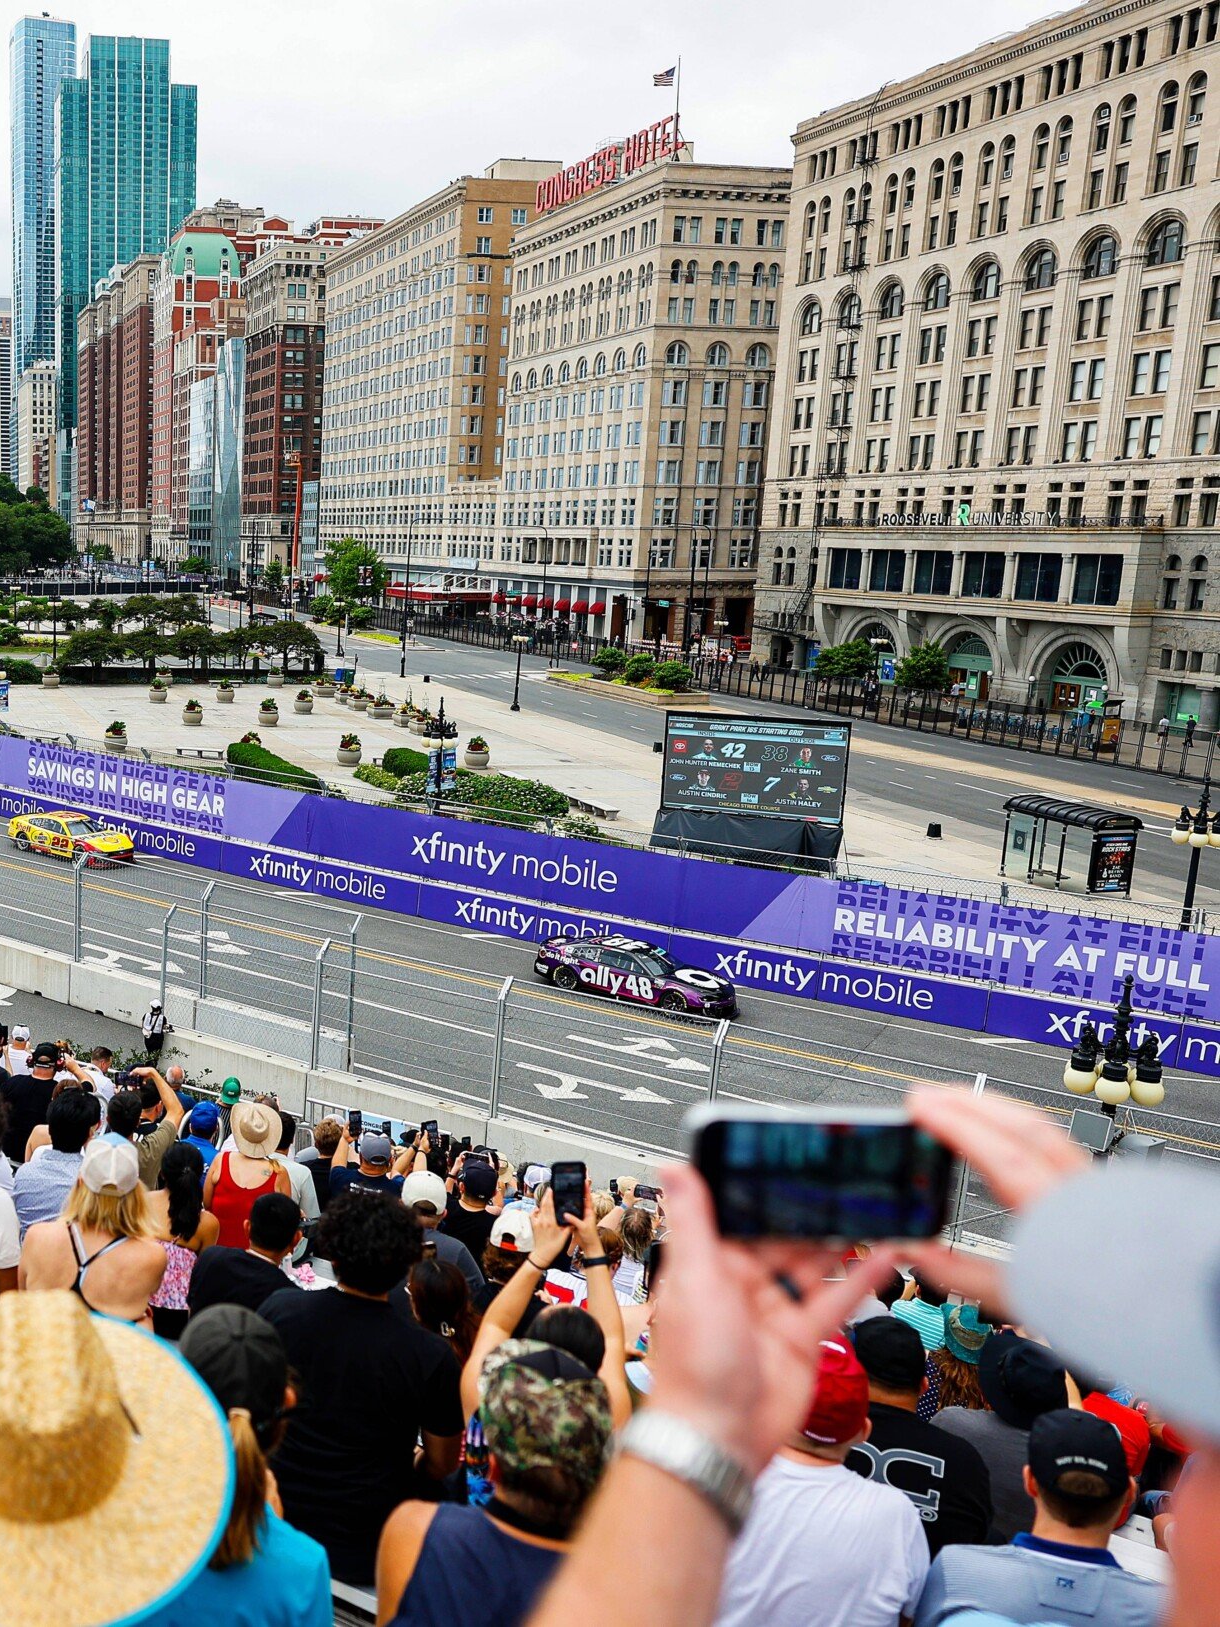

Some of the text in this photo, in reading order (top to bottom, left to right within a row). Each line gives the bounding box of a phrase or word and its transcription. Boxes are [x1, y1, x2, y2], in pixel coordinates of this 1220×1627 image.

[536, 112, 685, 213] CONGRESS HOTEL
[881, 512, 952, 526] ROOSEVELT
[972, 511, 1058, 526] UNIVERSITY
[709, 724, 730, 732] GRANT
[730, 725, 747, 733] PARK
[758, 727, 788, 736] STARTING
[788, 729, 804, 737] GRID
[720, 742, 747, 759] 42
[760, 744, 789, 762] 38
[684, 759, 708, 767] HUNTER
[708, 761, 741, 769] NEMECHEK
[798, 768, 822, 776] SMITH
[27, 757, 226, 816] SAVINGS IN HIGH GEAR
[763, 776, 781, 792] 7
[677, 789, 727, 799] AUSTIN CINDRIC
[718, 801, 740, 809] CHICAGO
[774, 798, 822, 808] JUSTIN HALEY
[15, 822, 32, 833] Shell
[51, 836, 70, 848] 22
[96, 816, 138, 841] finity
[140, 830, 195, 857] mobile
[411, 831, 618, 893] xfinity mobile
[250, 853, 386, 900] xfinity mobile
[454, 898, 536, 935] xfinity
[833, 908, 1211, 992] RELIABILITY AT FULL
[560, 955, 580, 966] right.
[580, 964, 624, 995] ally
[625, 974, 654, 1000] 48
[714, 949, 934, 1010] xfinity mobile
[1045, 1010, 1177, 1058] xfnty
[361, 1121, 383, 1129] CONGRE
